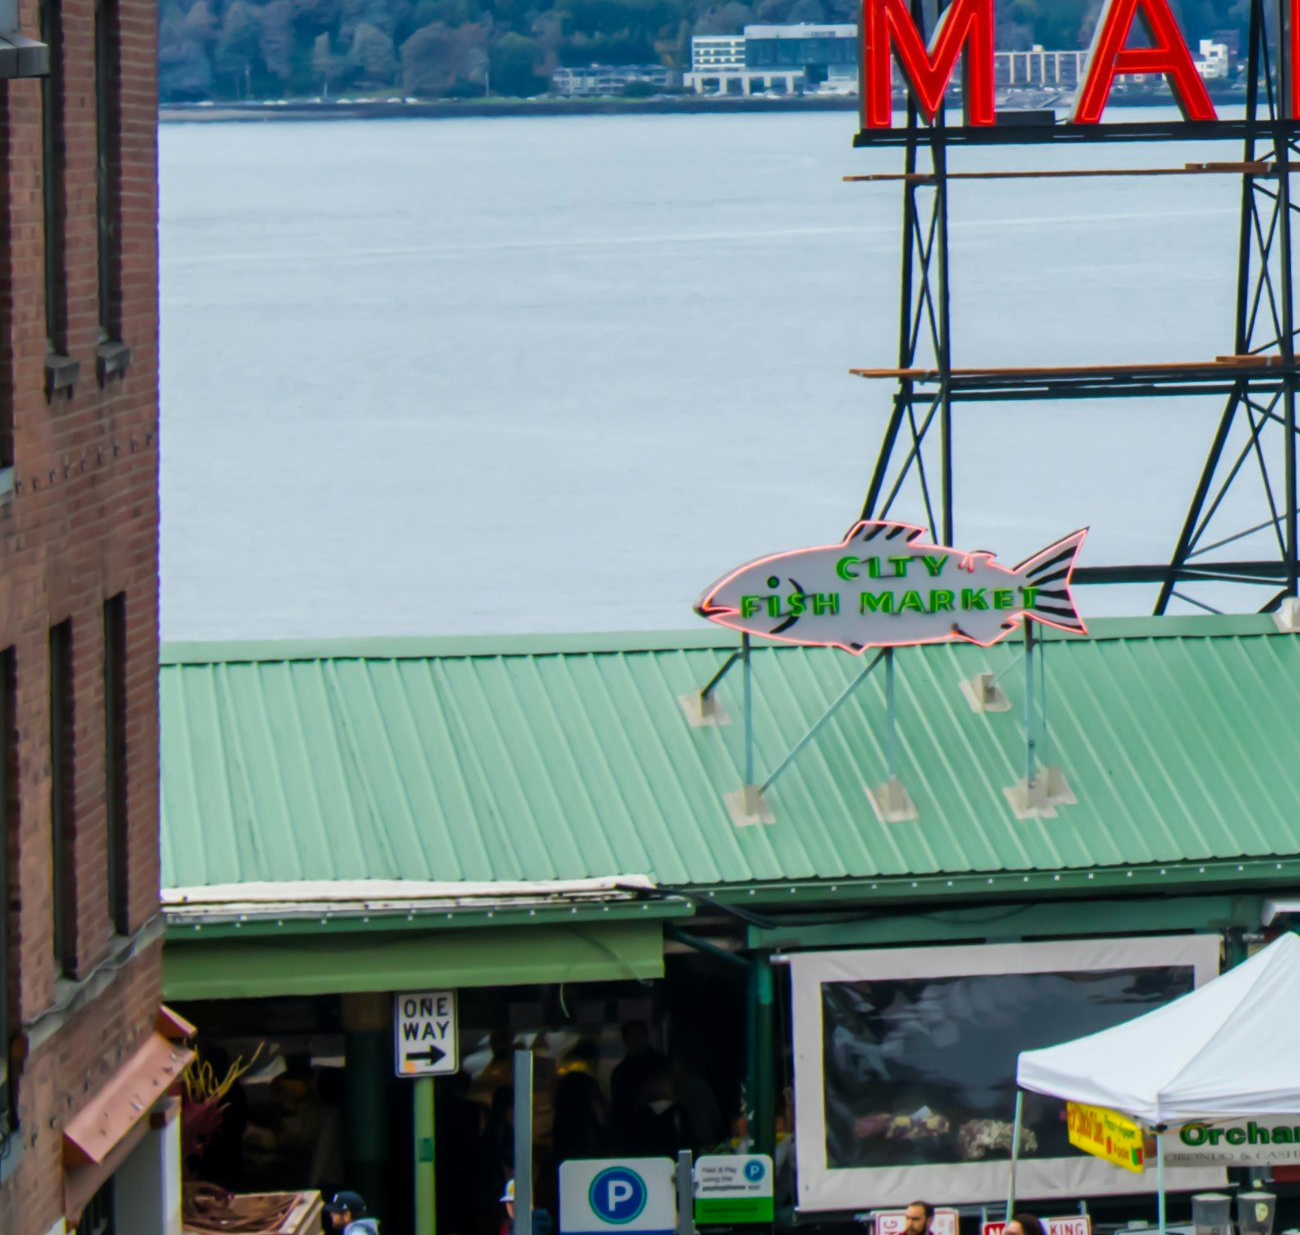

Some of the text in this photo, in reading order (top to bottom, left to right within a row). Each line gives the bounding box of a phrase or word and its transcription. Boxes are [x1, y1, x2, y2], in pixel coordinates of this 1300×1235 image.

[835, 555, 949, 582] CITY
[740, 585, 1041, 619] FISH MARKET
[404, 997, 449, 1019] ONE
[403, 1020, 450, 1041] WAY
[607, 1179, 634, 1213] P
[1049, 1223, 1084, 1235] KING
